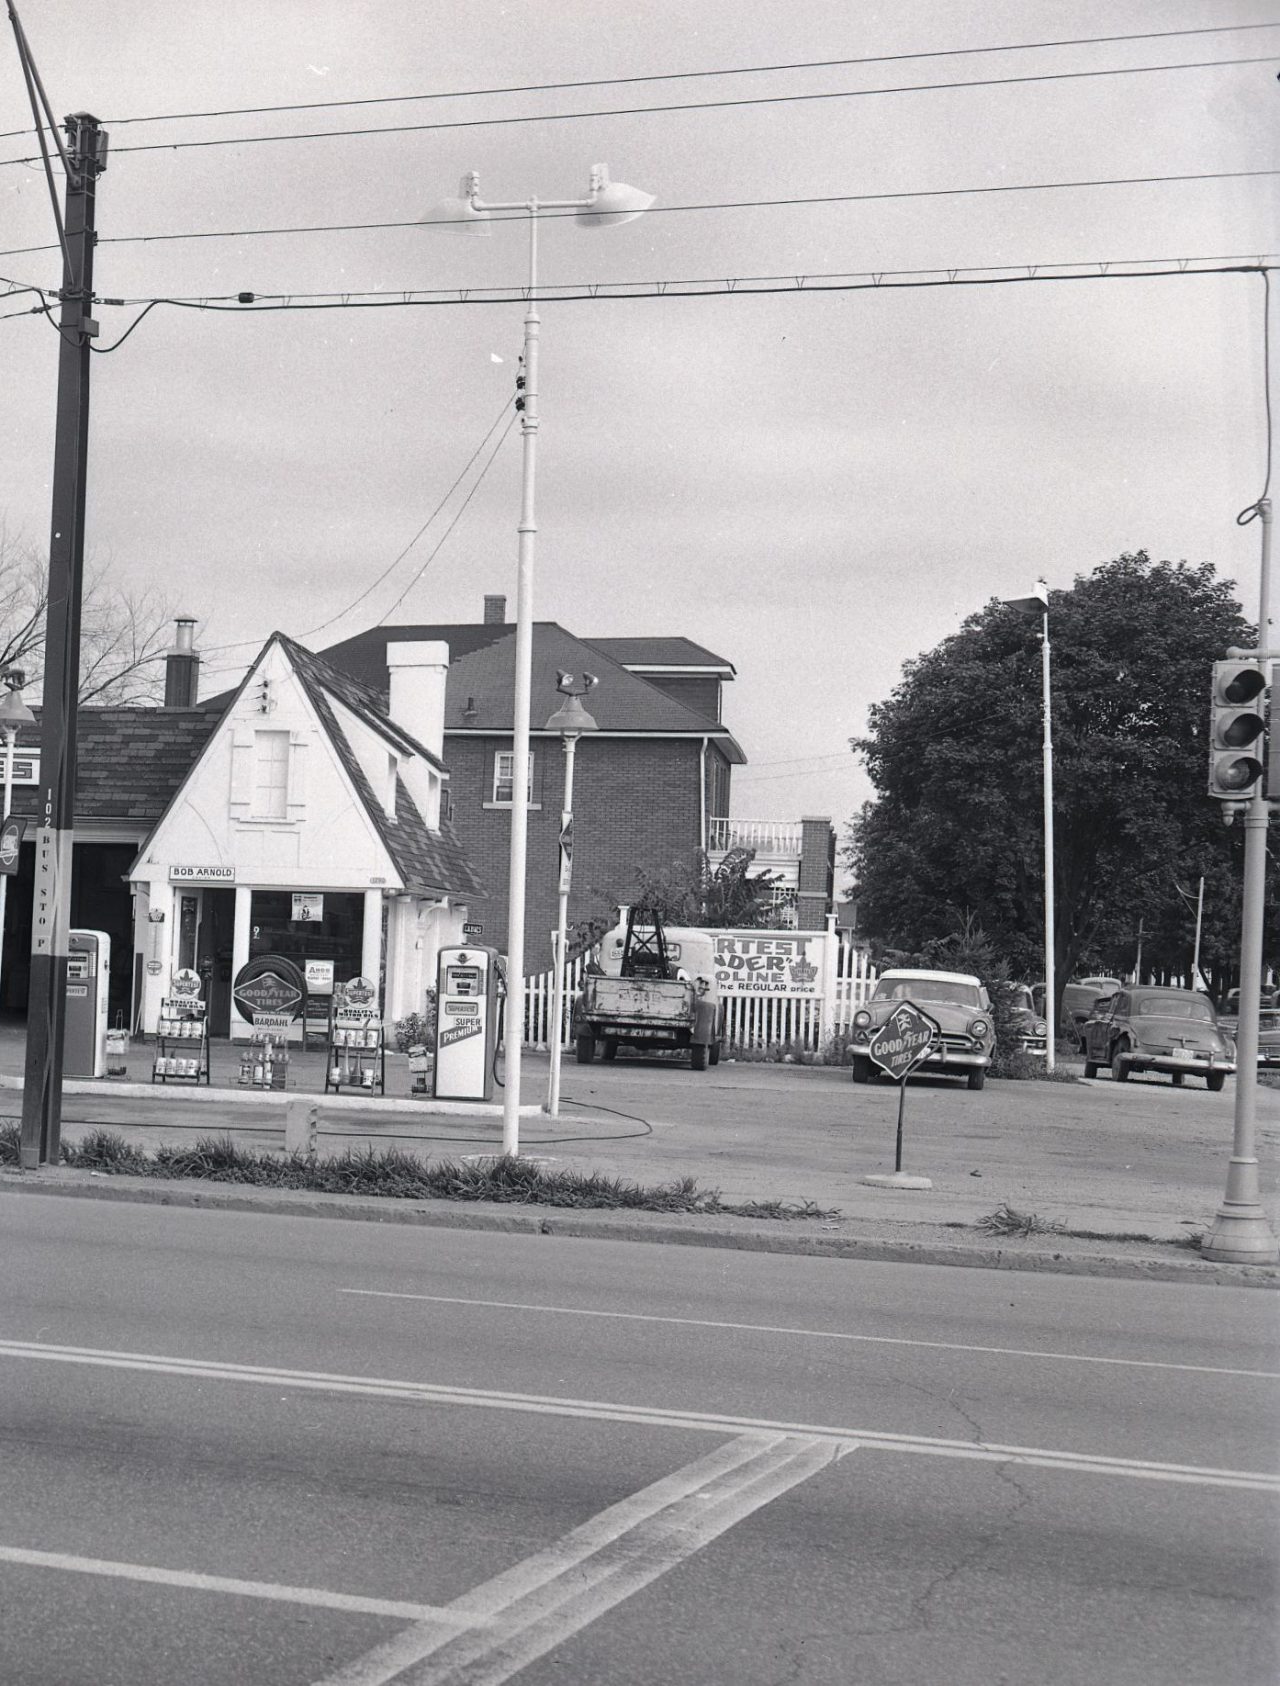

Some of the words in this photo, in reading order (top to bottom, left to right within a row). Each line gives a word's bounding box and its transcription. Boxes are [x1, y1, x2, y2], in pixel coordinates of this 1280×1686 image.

[42, 835, 50, 873] BUS
[173, 867, 194, 876] BOB
[196, 868, 232, 877] ARNOLD
[38, 888, 48, 948] STOP
[713, 937, 812, 956] RTEST
[715, 970, 785, 983] OLINE
[717, 981, 734, 990] he
[738, 983, 787, 992] REGULAR
[255, 998, 283, 1006] TIRES
[254, 1017, 289, 1027] BARDAHL
[456, 1018, 481, 1026] SUPER
[443, 1023, 479, 1043] PREMIUM
[890, 1051, 913, 1068] TIRES
